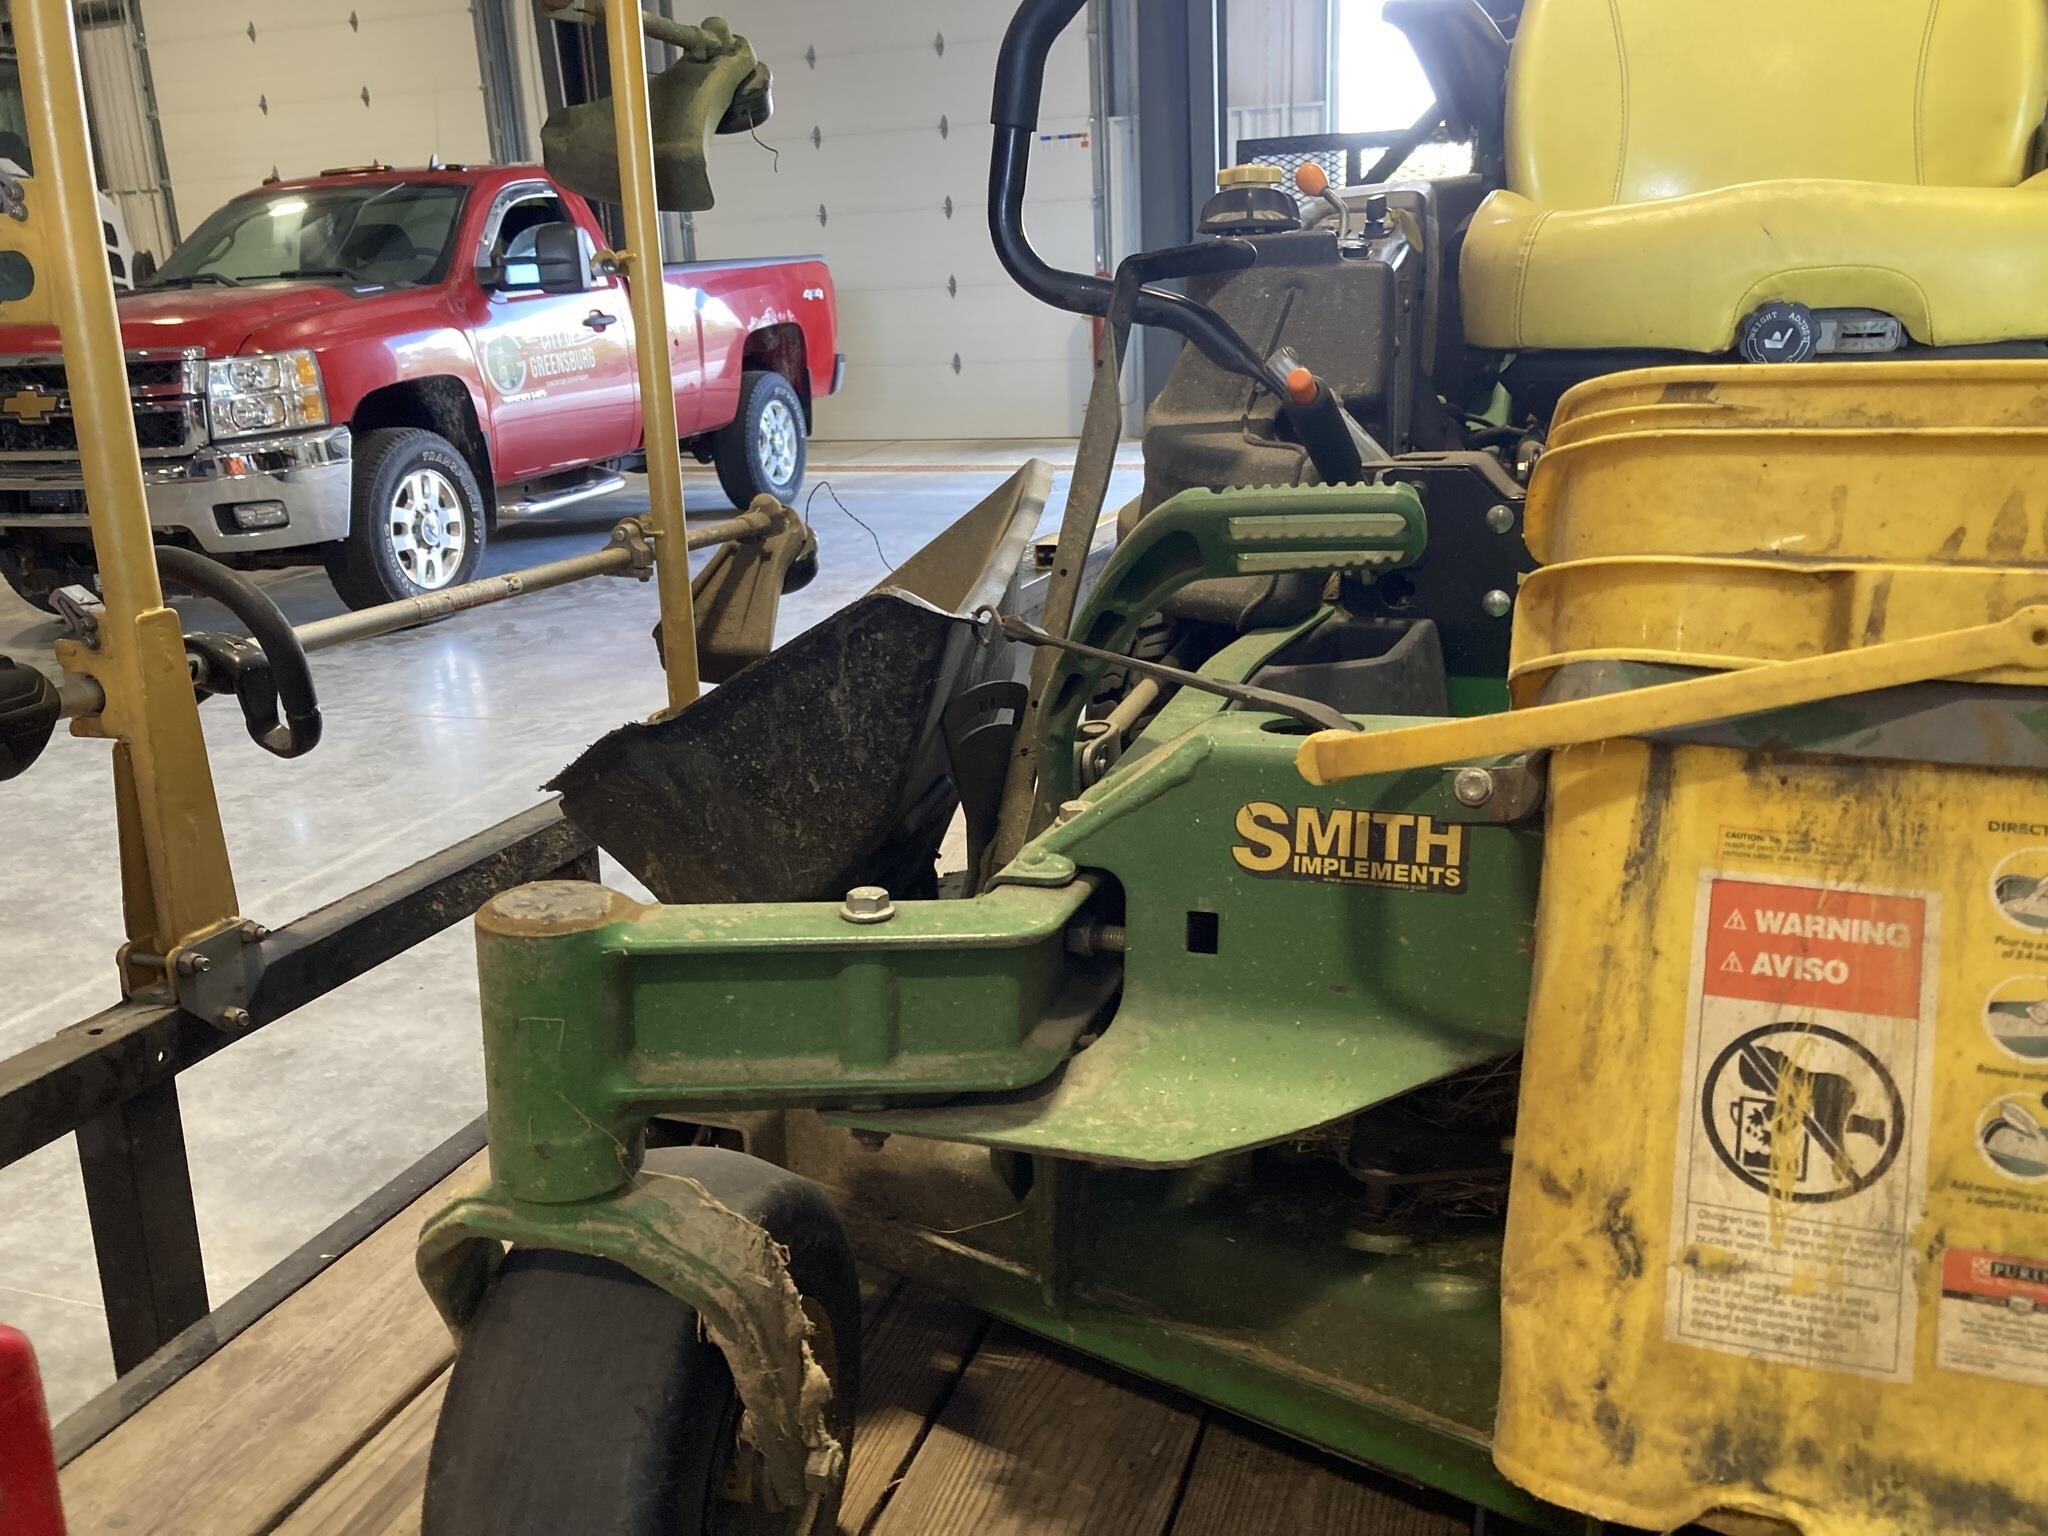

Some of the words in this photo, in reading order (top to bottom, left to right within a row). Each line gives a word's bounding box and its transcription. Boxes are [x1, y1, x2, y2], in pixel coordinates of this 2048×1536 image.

[1750, 311, 1777, 339] WEIGHT
[1788, 312, 1811, 343] ADJUST
[529, 347, 596, 378] GREENSBURG
[1232, 801, 1462, 872] SMITH
[1293, 854, 1461, 887] IMPLEMENTS
[1755, 909, 1911, 949] WARNING
[1751, 951, 1849, 985] AVISO
